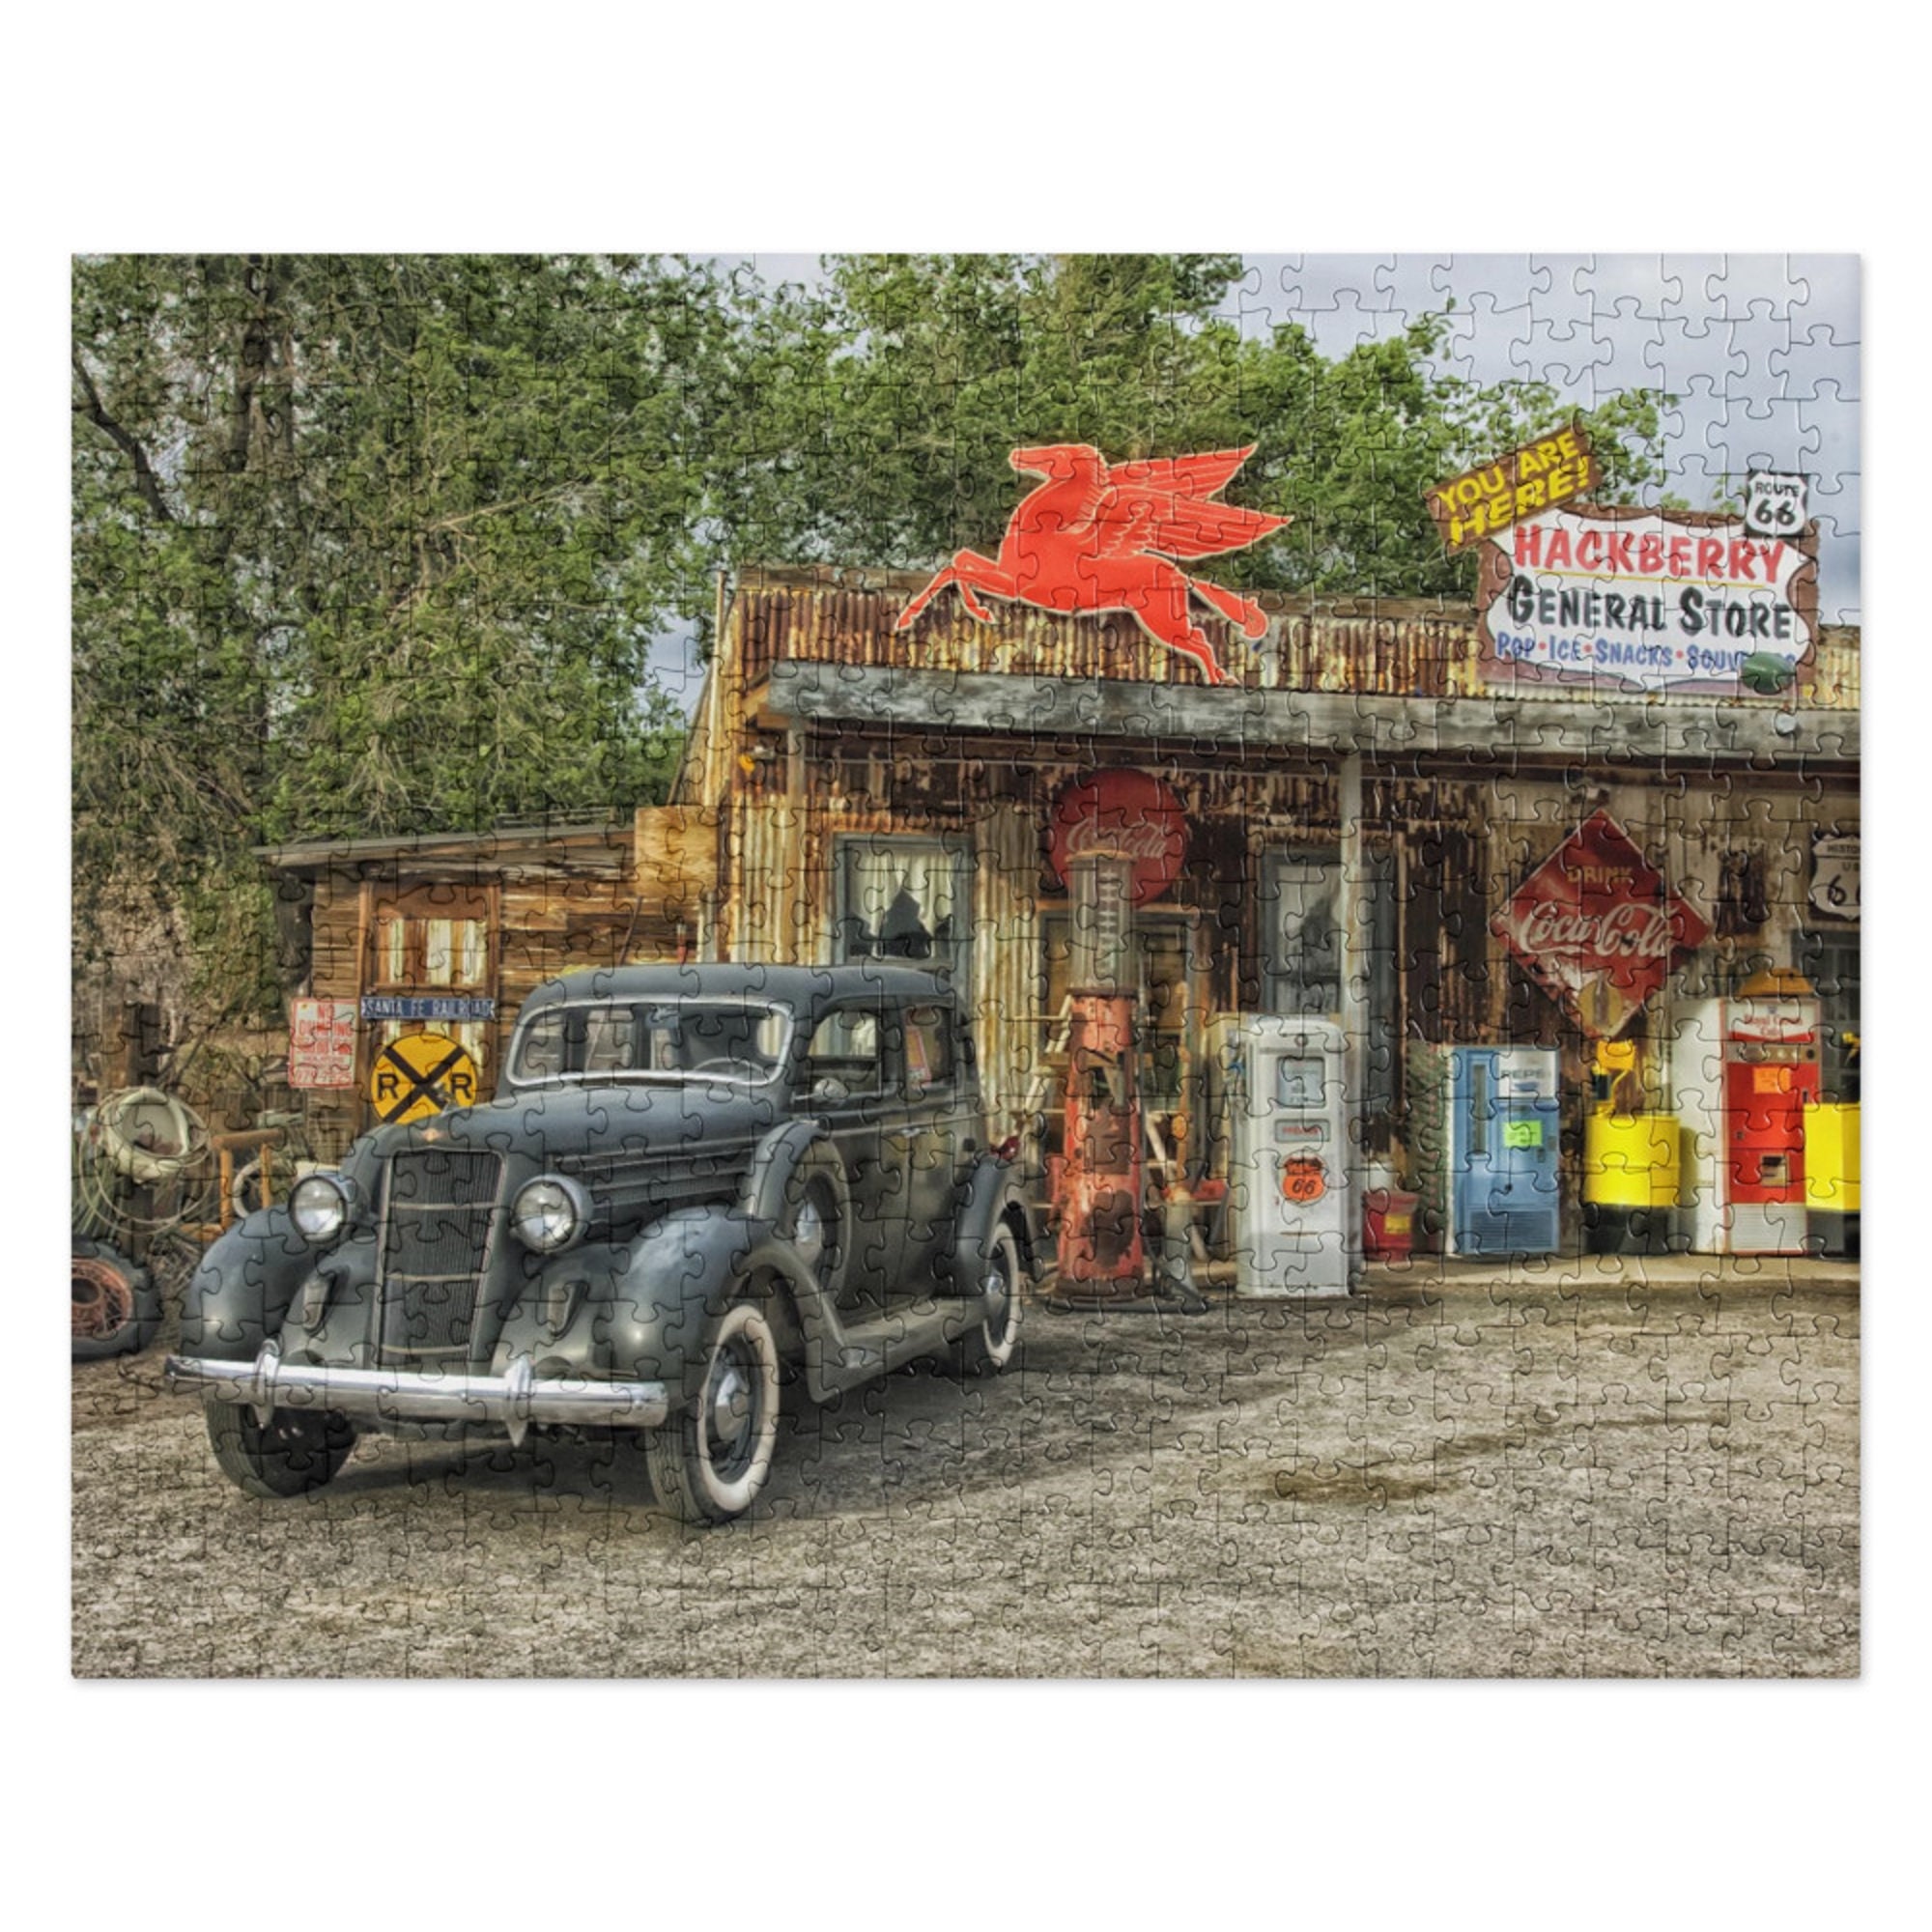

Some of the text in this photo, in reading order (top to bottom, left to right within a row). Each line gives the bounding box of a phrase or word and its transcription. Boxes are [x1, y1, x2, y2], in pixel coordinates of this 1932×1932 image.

[1436, 432, 1579, 513] YOU ARE
[1450, 455, 1590, 546] HERE!
[1754, 481, 1801, 498] ROUTE
[1755, 498, 1796, 526] 66
[1515, 523, 1785, 583] HACKBERRY
[1507, 574, 1791, 639] GENERAL STORE
[1496, 631, 1536, 658] POP
[1549, 635, 1582, 662] ICE
[1595, 638, 1673, 668] SNACKS
[1567, 865, 1634, 884] DRINK
[368, 999, 403, 1016] SANTA
[412, 999, 426, 1016] FE
[378, 1073, 399, 1100] R
[450, 1073, 472, 1099] R
[1292, 1178, 1317, 1196] 66
